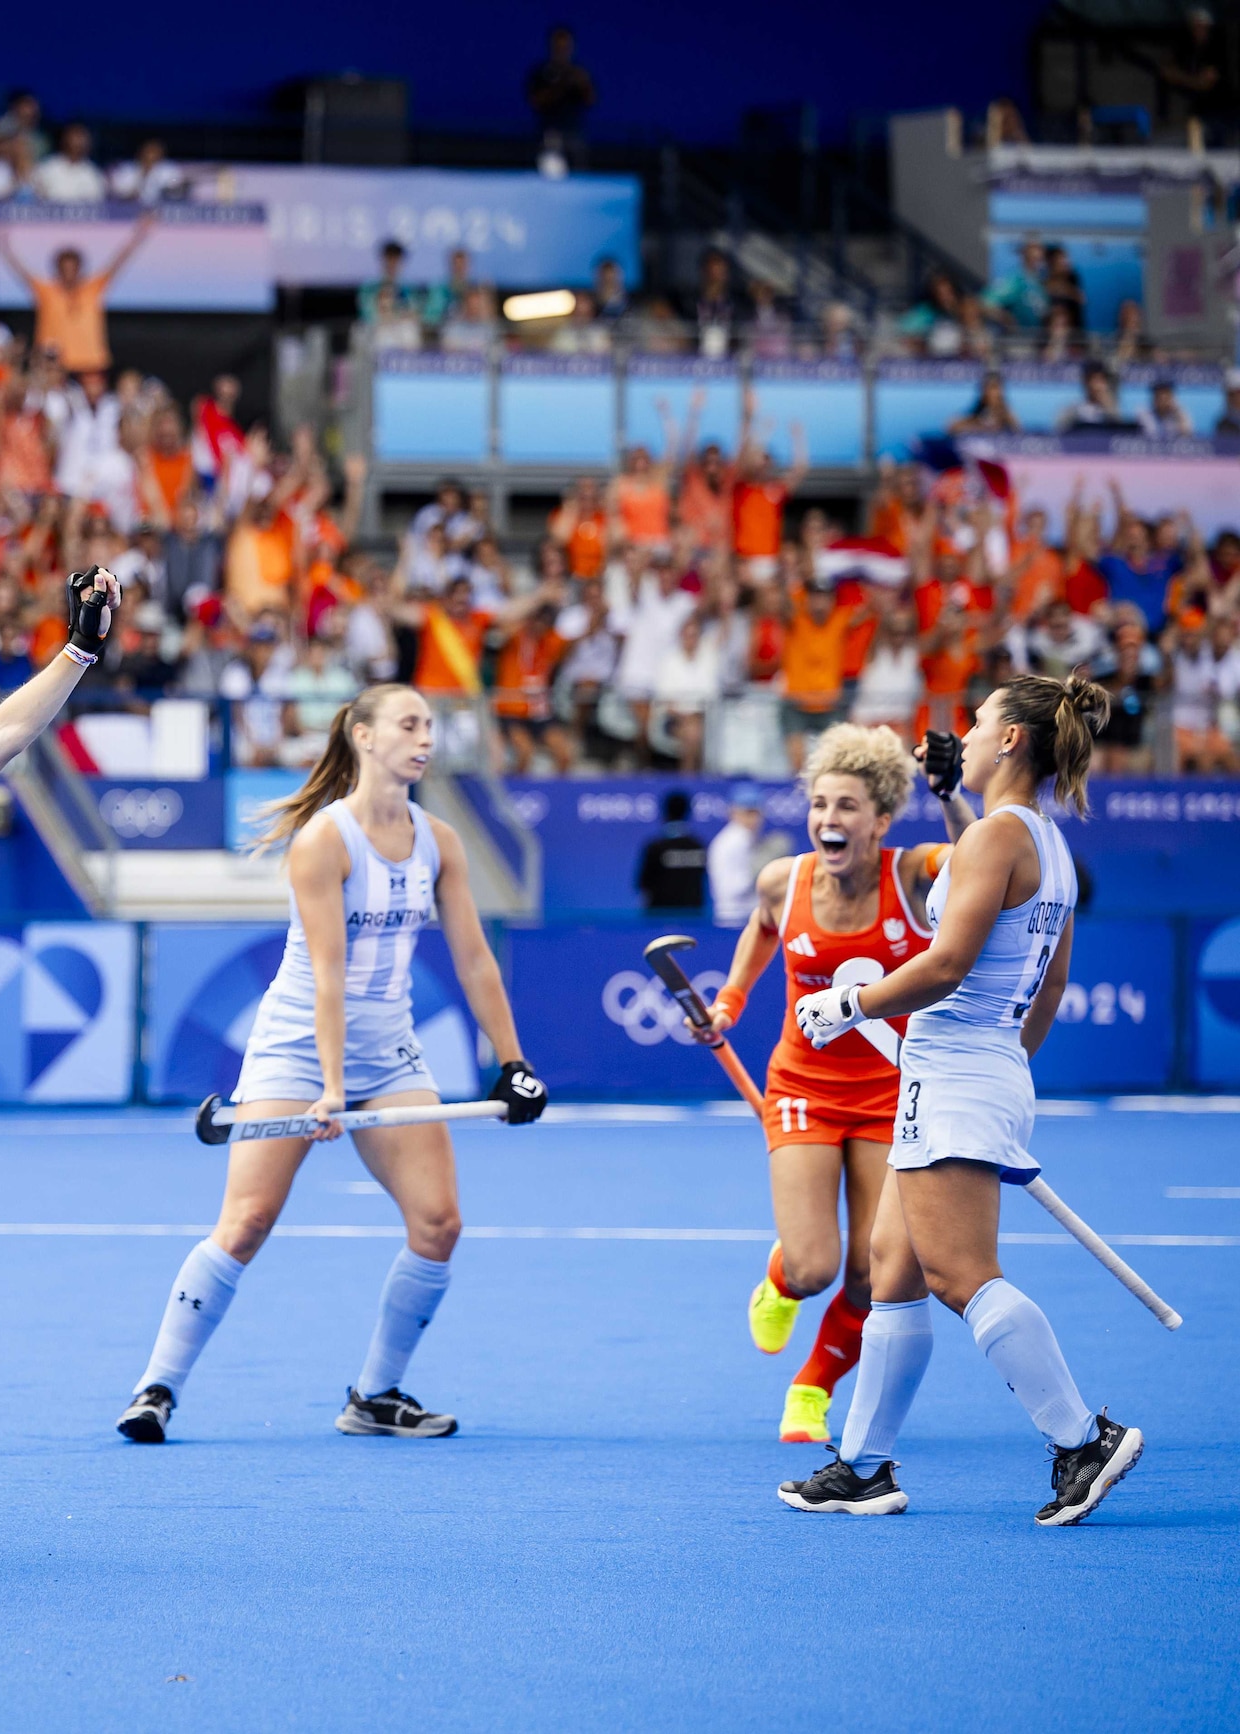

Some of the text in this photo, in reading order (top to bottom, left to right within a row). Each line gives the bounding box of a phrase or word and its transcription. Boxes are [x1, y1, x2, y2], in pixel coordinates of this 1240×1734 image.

[576, 792, 658, 822] PARIS
[1106, 792, 1240, 821] PARIS 202
[1057, 982, 1146, 1025] 024
[776, 1096, 808, 1133] 11
[905, 1081, 921, 1122] 3
